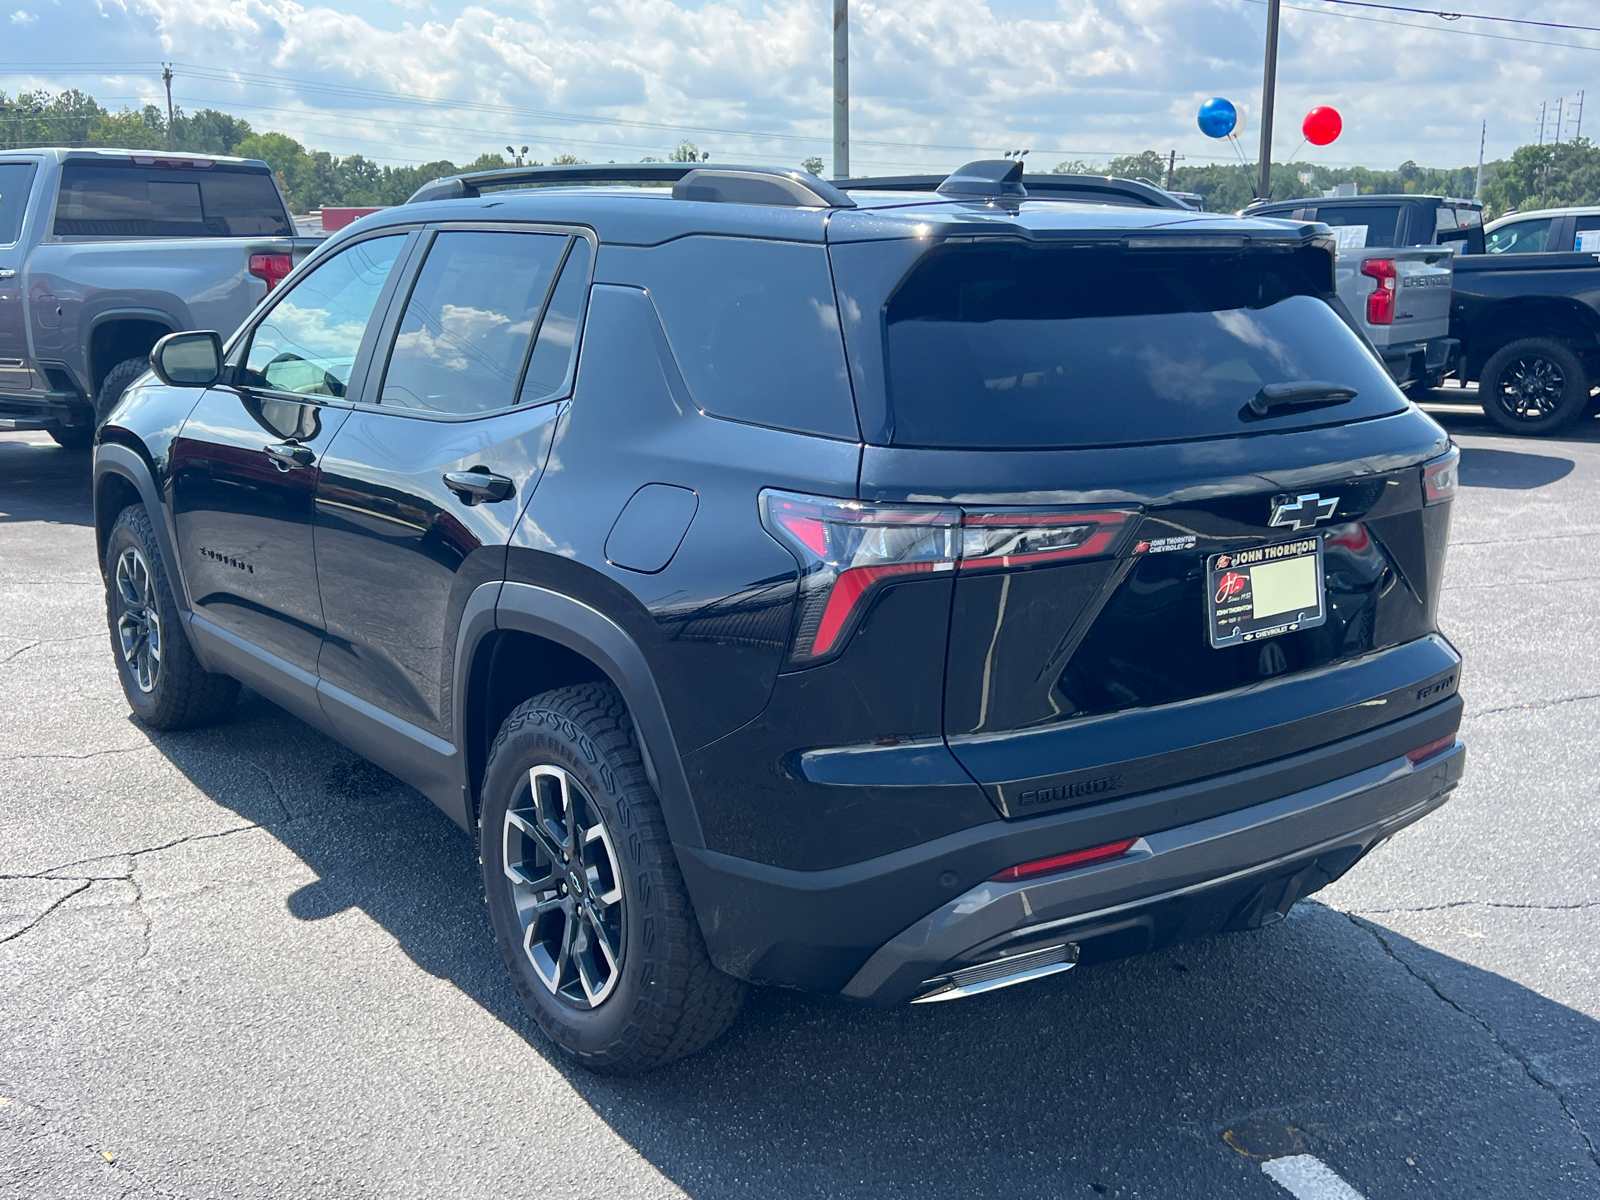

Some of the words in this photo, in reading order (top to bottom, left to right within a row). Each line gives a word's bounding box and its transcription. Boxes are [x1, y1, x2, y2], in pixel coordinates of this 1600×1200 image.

[1150, 538, 1165, 547] JOHN
[1166, 535, 1196, 545] THORNTON
[1149, 543, 1184, 553] CHEVROLET
[1233, 548, 1263, 565] JOHN
[1265, 540, 1316, 558] THORNTON
[1216, 608, 1228, 616] JOHN
[1228, 604, 1252, 613] THORNTON
[1255, 625, 1288, 638] CHEVROLET
[1019, 774, 1125, 806] EQUINOX
